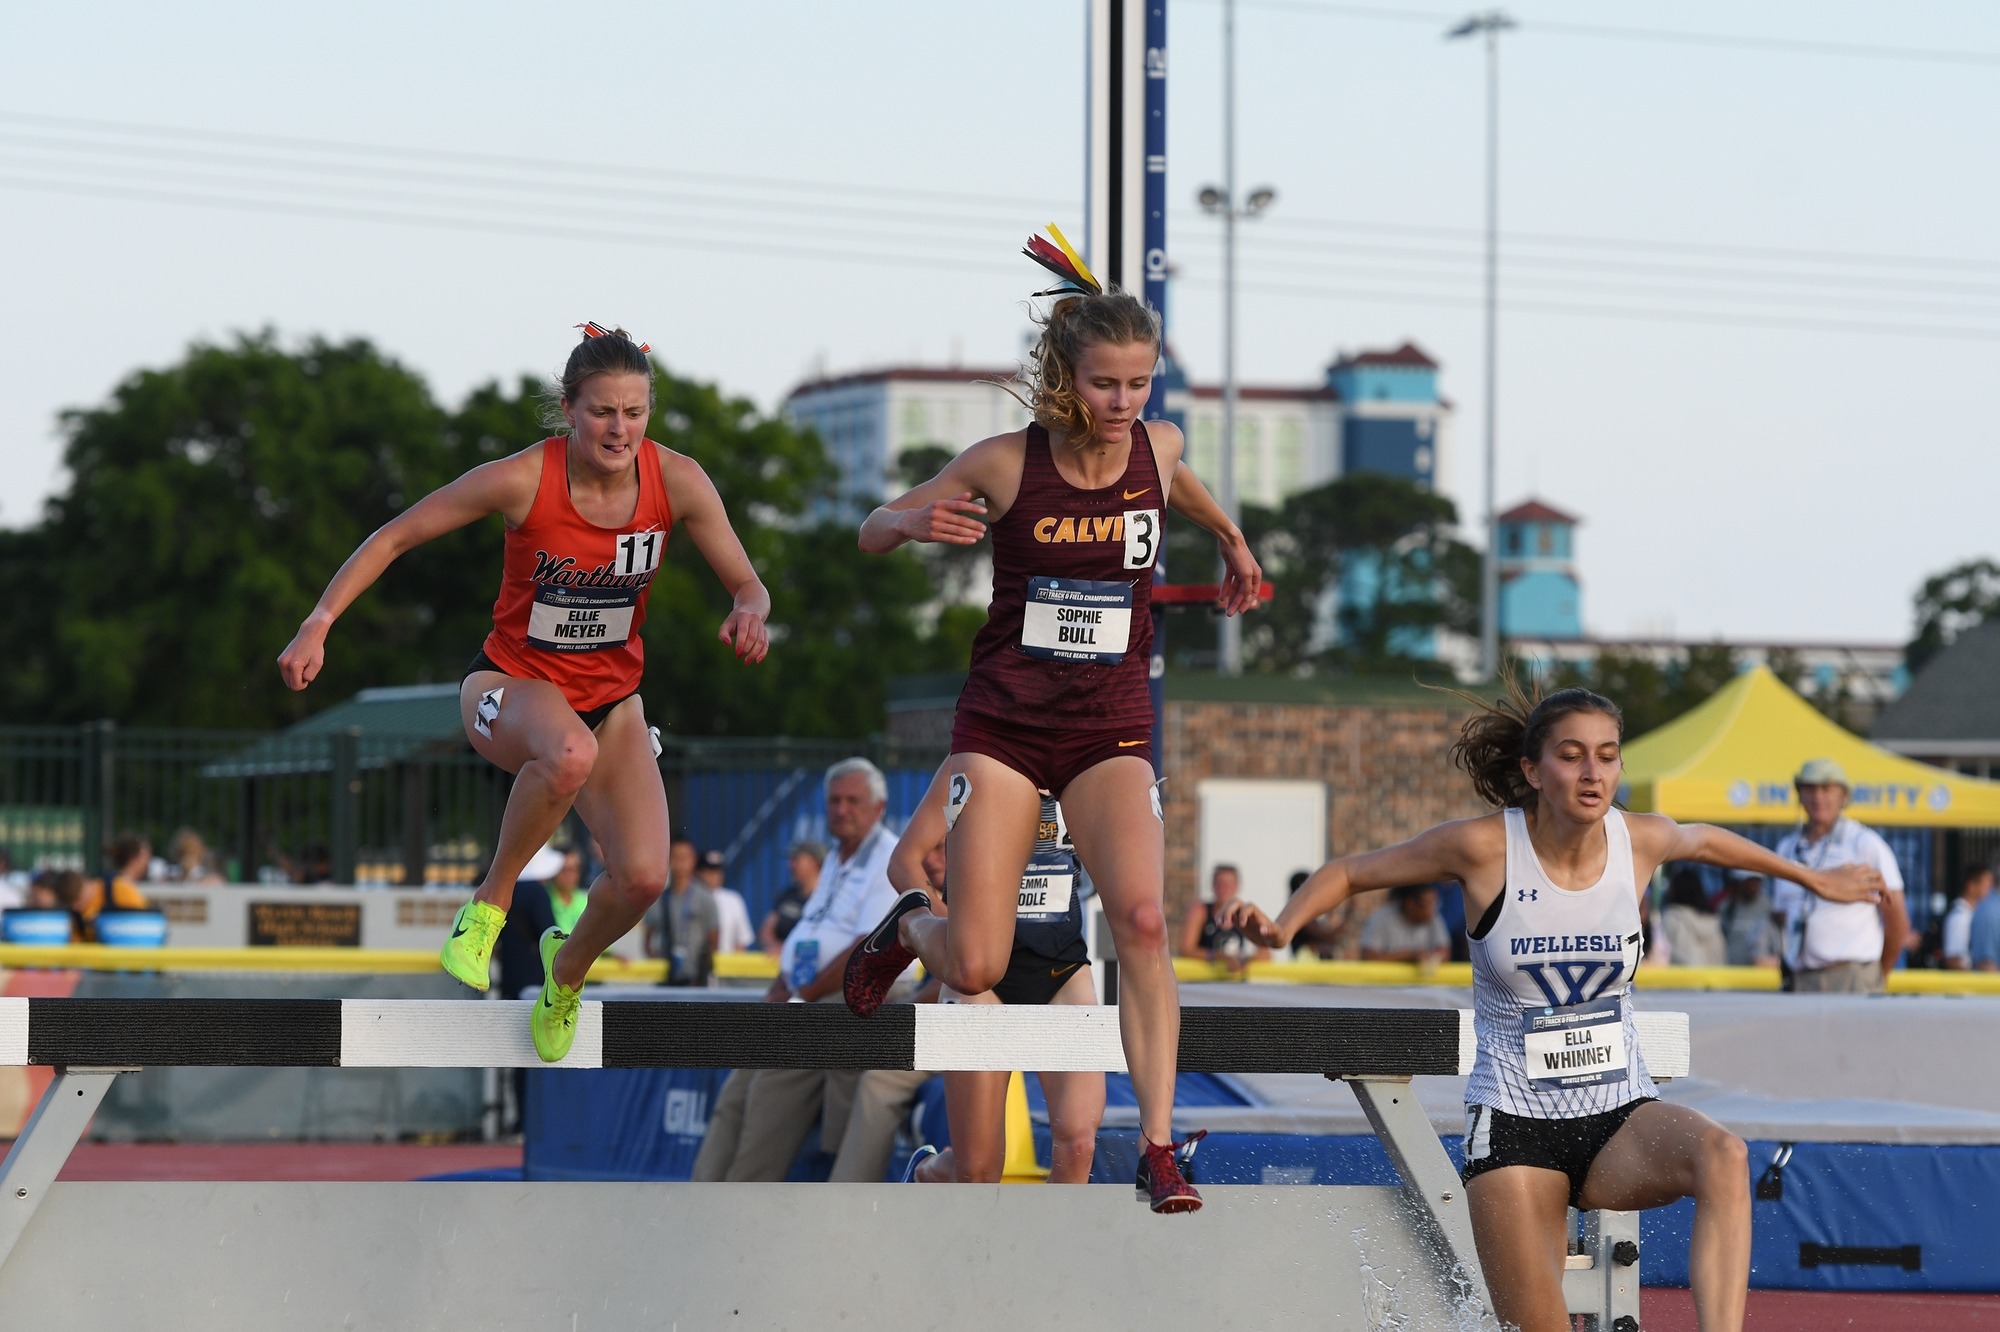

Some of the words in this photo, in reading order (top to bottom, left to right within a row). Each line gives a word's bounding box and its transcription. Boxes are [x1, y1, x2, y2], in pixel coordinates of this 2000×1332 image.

[1034, 516, 1127, 543] CALVI
[1132, 512, 1153, 566] 3
[621, 533, 655, 574] 11
[568, 610, 600, 621] ELLIE
[1057, 608, 1102, 624] SOPHIE
[554, 624, 607, 638] MEYER
[1058, 626, 1096, 645] BULL
[1020, 877, 1048, 889] EMMA
[1018, 892, 1047, 906] ODLE
[1511, 934, 1623, 955] WELLESL
[1514, 959, 1625, 1007] W
[1565, 1030, 1592, 1046] ELLA
[1543, 1045, 1612, 1070] WHINNEY
[1467, 1104, 1483, 1156] 7
